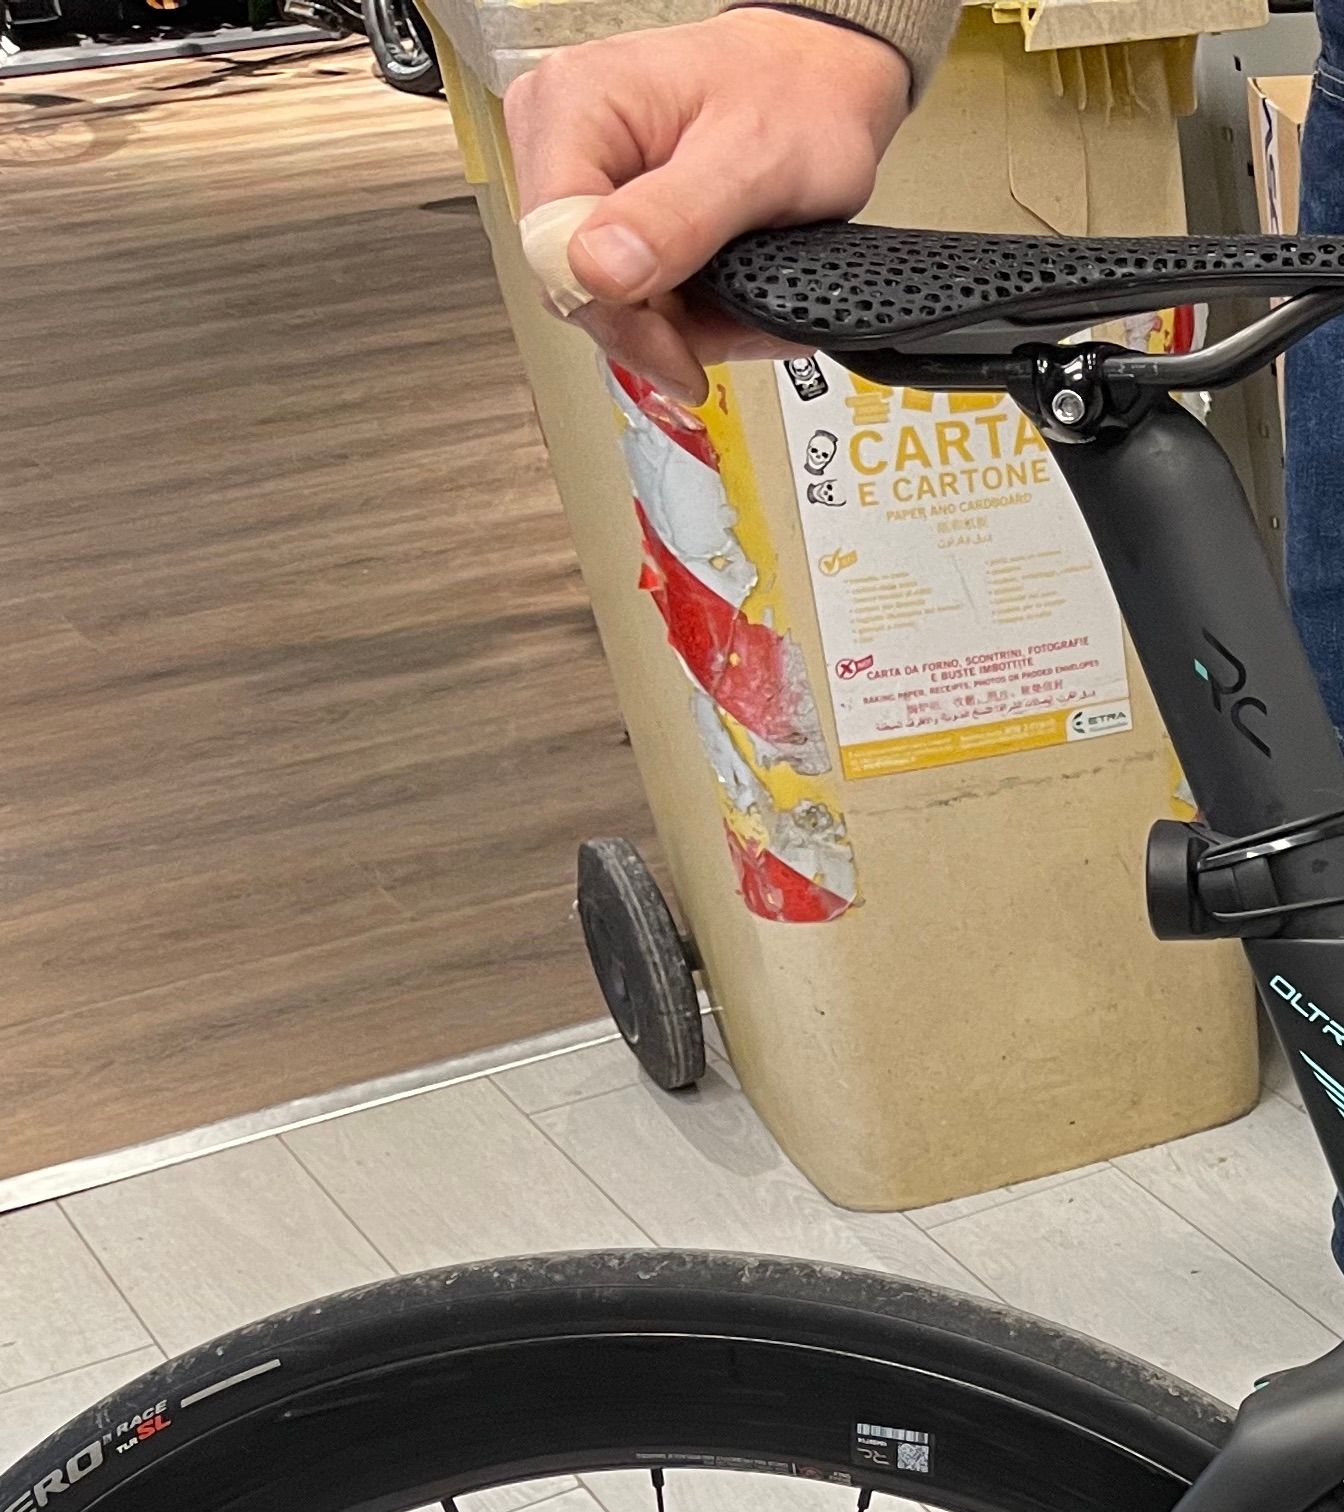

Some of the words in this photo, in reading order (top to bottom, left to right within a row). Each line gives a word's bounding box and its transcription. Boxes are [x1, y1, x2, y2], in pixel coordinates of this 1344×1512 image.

[850, 412, 1047, 476] CARTA
[857, 482, 879, 506] E
[892, 459, 1050, 502] CARTONE
[886, 507, 927, 521] PAPER
[930, 503, 956, 517] AND
[959, 493, 1032, 513] CARDBOARD
[866, 666, 901, 681] CARTA
[904, 664, 919, 677] DA
[1028, 637, 1090, 655] FOTOGRAFIE
[941, 667, 976, 682] BUSTE
[979, 659, 1034, 674] IMBOTTITE
[1087, 711, 1127, 725] ETRA
[116, 1400, 167, 1437] RACE
[116, 1437, 139, 1454] TLR
[137, 1415, 171, 1441] SL
